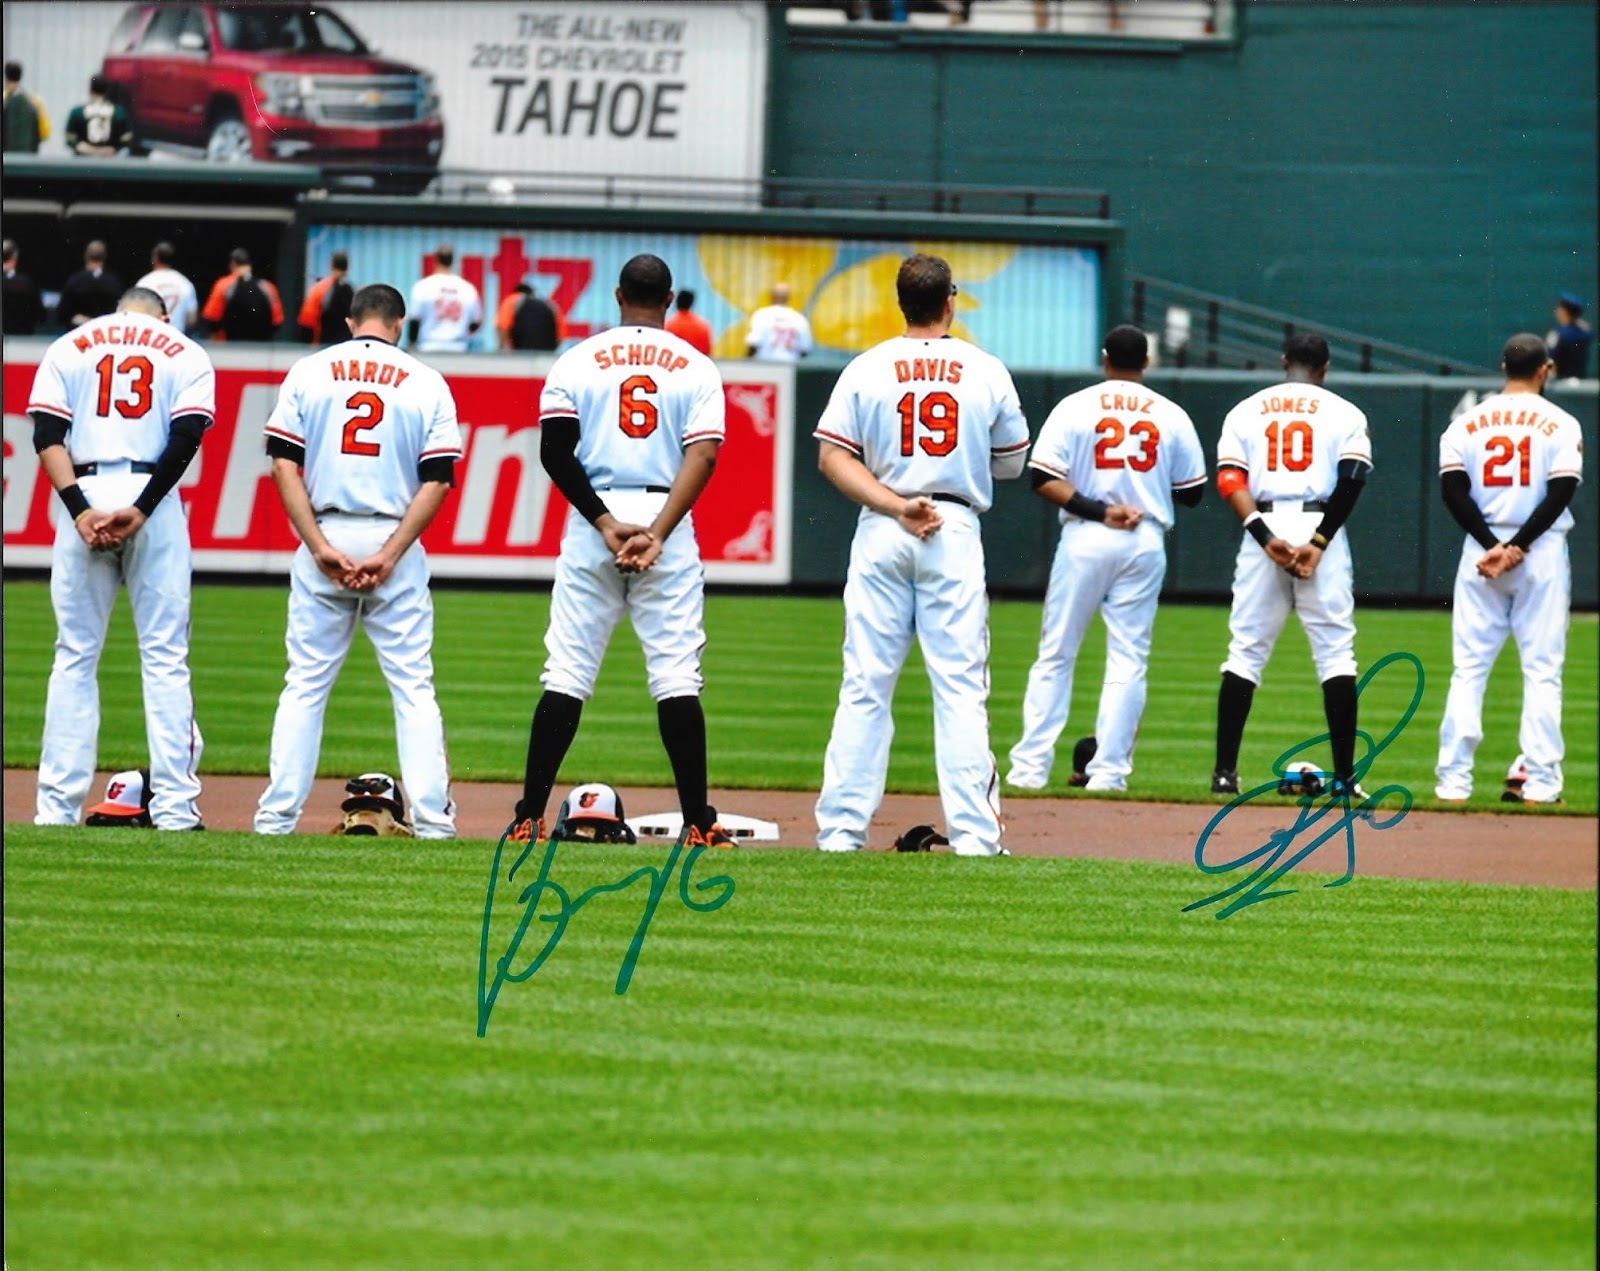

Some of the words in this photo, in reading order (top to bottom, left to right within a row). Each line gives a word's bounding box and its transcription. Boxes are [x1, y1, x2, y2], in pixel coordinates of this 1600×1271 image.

[517, 14, 562, 40] THE
[567, 15, 687, 43] ALL-NEW
[470, 43, 528, 70] 2015
[536, 46, 684, 74] CHEVROLET
[490, 77, 686, 139] TAHOE
[73, 325, 185, 358] MACHADO
[594, 343, 690, 373] SCHOOP
[95, 353, 154, 419] 13
[330, 359, 410, 389] HARDY
[894, 358, 963, 384] DAVIS
[618, 374, 659, 439] 6
[1100, 393, 1155, 414] CRUZ
[1260, 396, 1320, 415] JONES
[341, 390, 385, 457] 2
[896, 391, 959, 457] 19
[1465, 410, 1559, 437] MARKAKIS
[1094, 416, 1160, 473] 23
[1264, 420, 1314, 472] 10
[1482, 435, 1531, 487] 21
